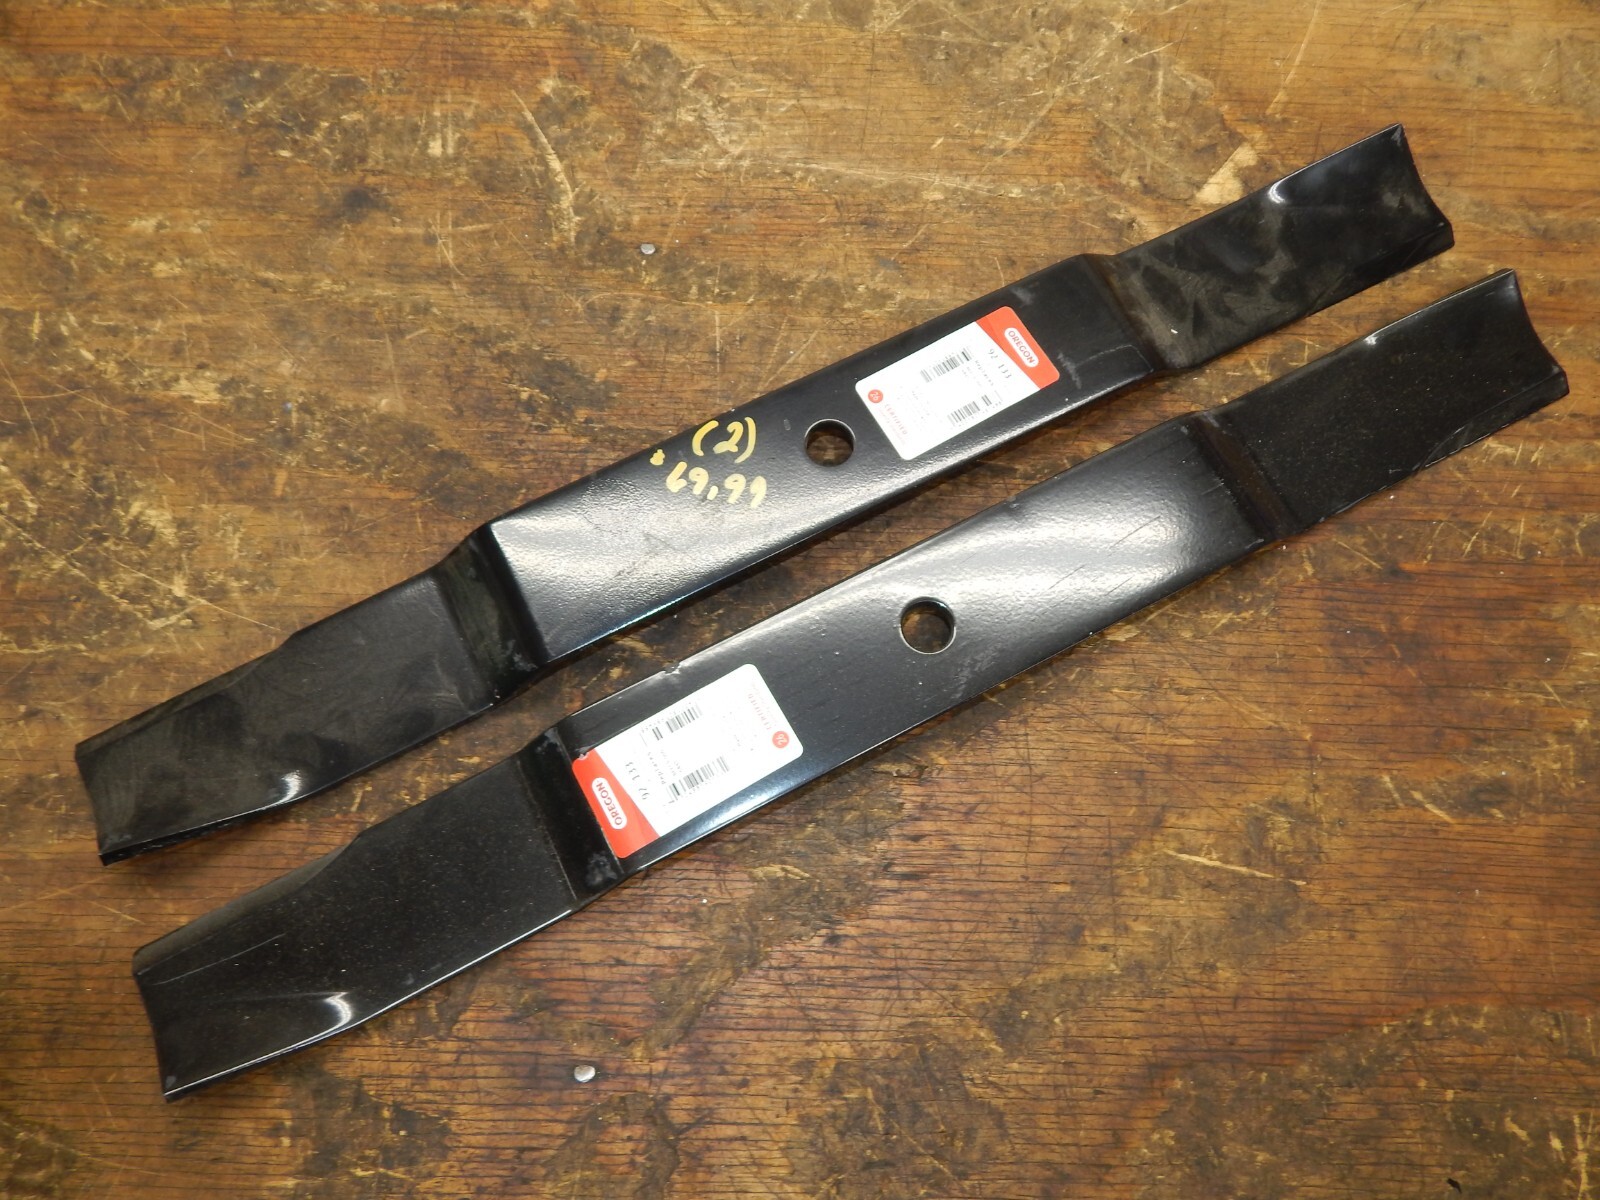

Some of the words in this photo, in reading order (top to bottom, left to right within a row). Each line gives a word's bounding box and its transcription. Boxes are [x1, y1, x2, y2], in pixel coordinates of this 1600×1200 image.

[987, 348, 998, 360] 92
[1007, 329, 1035, 364] OREGON
[692, 416, 756, 463] (2)
[594, 781, 625, 826] OREGON
